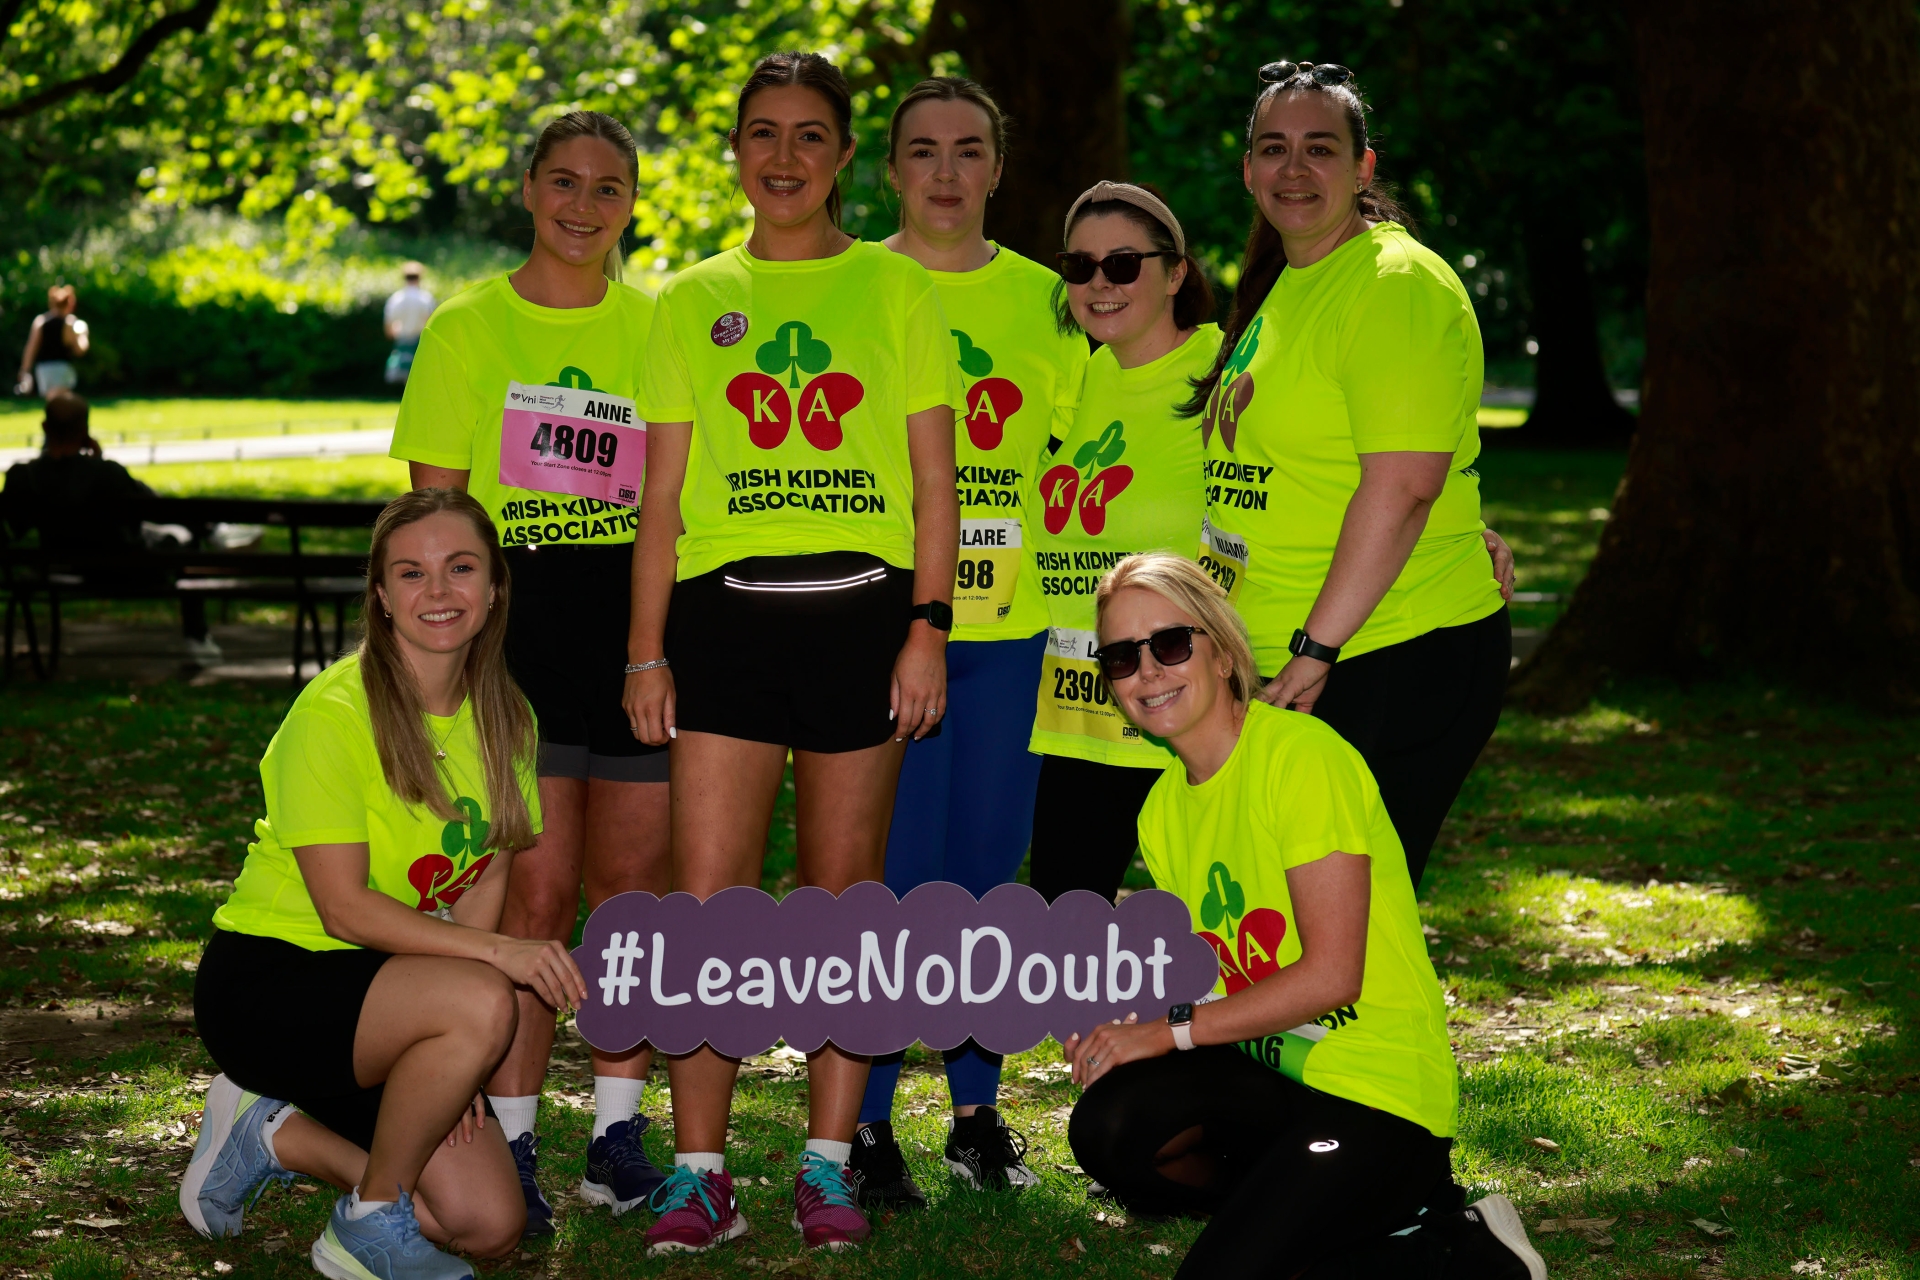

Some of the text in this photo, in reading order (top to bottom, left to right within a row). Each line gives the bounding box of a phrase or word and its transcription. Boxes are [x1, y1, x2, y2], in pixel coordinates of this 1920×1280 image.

[584, 399, 632, 425] ANNE
[753, 388, 836, 423] K A
[970, 390, 999, 424] A
[1221, 387, 1236, 423] A
[530, 422, 618, 468] 4809
[571, 465, 587, 473] closes
[787, 469, 876, 489] KIDNEY
[728, 491, 886, 515] ASSOCIATION
[1048, 478, 1105, 508] K A
[501, 499, 560, 521] IRISH
[502, 512, 640, 545] ASSOCIATIO
[960, 528, 1006, 546] LARE
[1036, 552, 1071, 571] RISH
[1054, 667, 1118, 707] 2390
[598, 923, 1173, 1009] #LeaveNoDoubt
[1245, 931, 1271, 970] A
